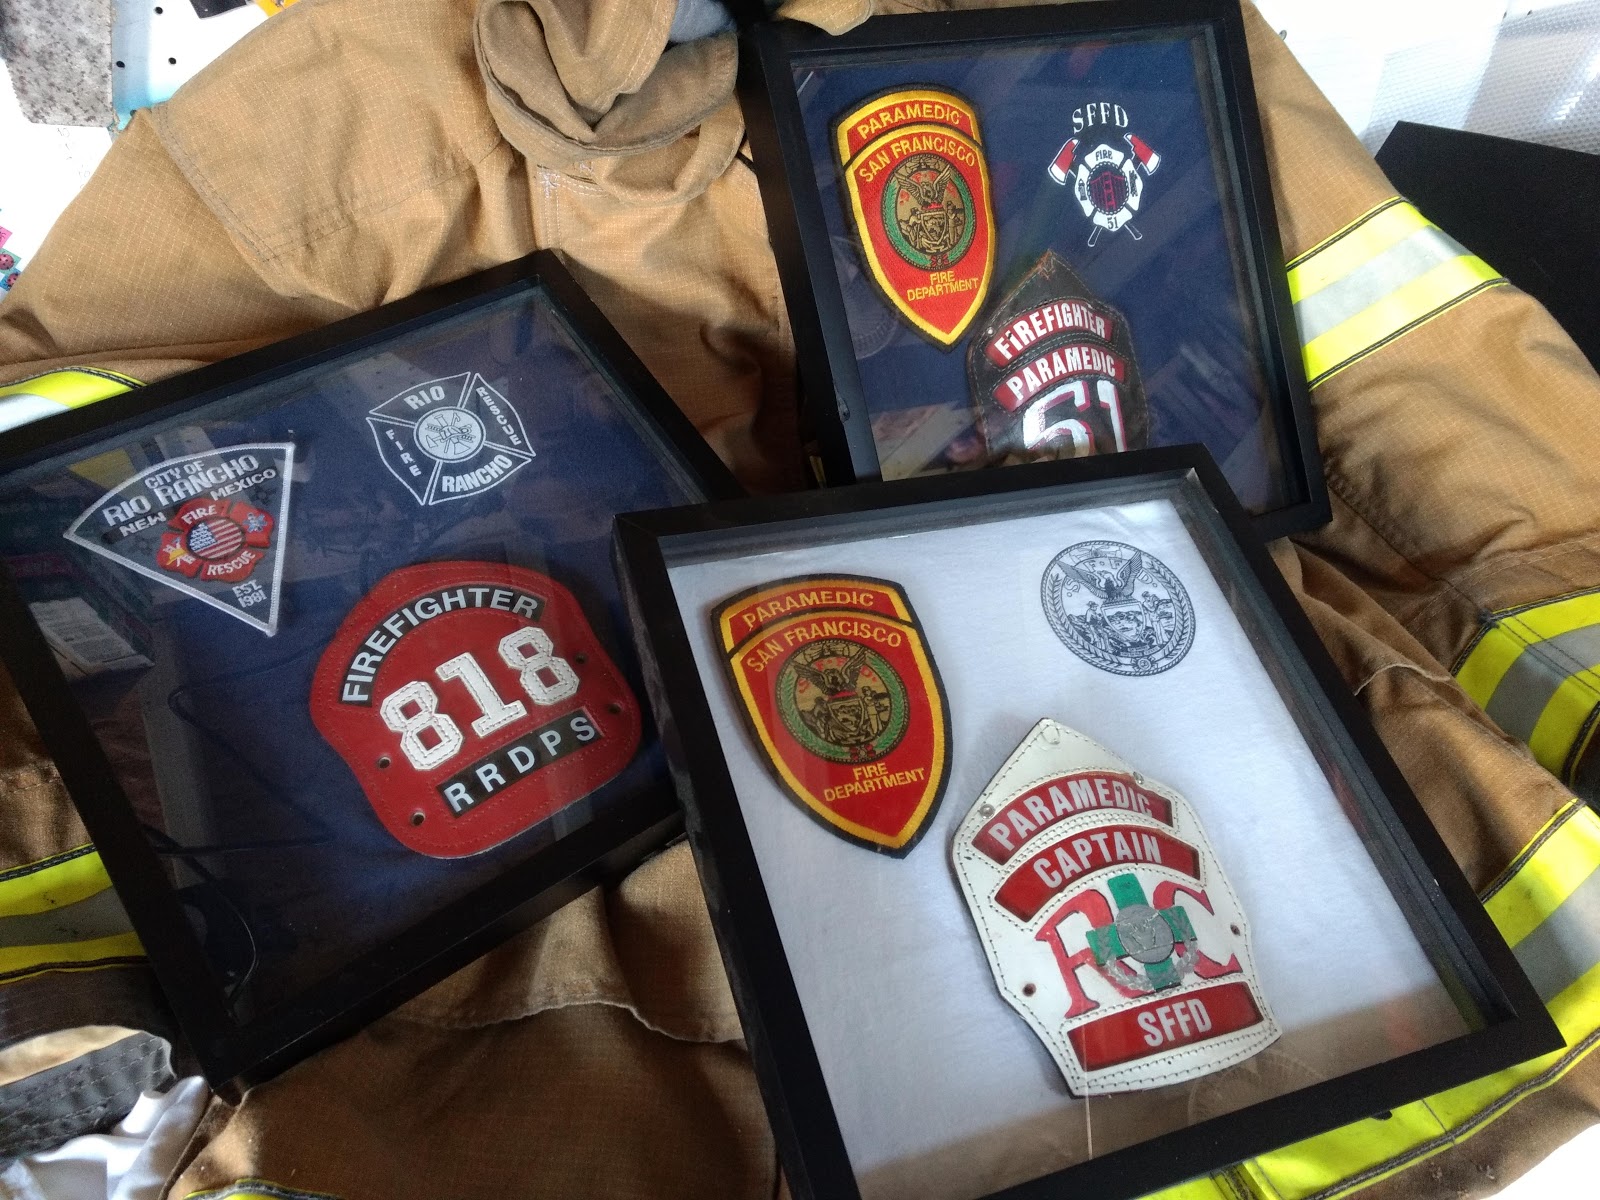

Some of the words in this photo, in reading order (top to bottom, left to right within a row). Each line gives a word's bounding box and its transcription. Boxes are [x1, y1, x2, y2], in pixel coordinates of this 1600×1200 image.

[857, 104, 961, 139] PARAMEDIC
[1072, 102, 1129, 134] SFFD
[859, 150, 891, 182] SAN
[890, 136, 975, 167] FRANCISCO
[1095, 149, 1113, 161] FIRE
[1107, 216, 1119, 230] 51
[907, 278, 979, 301] DEPARTMENT
[930, 271, 956, 285] FIRE
[1006, 346, 1117, 401] PARAMEDIC
[403, 385, 446, 410] RIO
[475, 386, 522, 446] RESCUE
[385, 429, 422, 477] FIRE
[102, 494, 152, 527] RIO
[153, 454, 260, 507] RANCHO
[144, 468, 182, 490] CITY
[183, 460, 205, 475] OF
[441, 454, 513, 493] RANCHO
[119, 511, 168, 538] NEW
[209, 468, 277, 502] MEXICO
[181, 504, 218, 526] FIRE
[206, 549, 257, 577] RESCUE
[238, 589, 268, 608] 1981
[742, 590, 875, 630] PARAMEDIC
[341, 587, 539, 703] FIREFIGHTER
[746, 639, 785, 674] SAN
[784, 620, 902, 649] FRANCISCO
[379, 625, 581, 772] 818
[823, 767, 926, 802] DEPARTMENT
[852, 762, 889, 781] FIRE
[988, 778, 1153, 851] PARAMEDIC
[1032, 831, 1163, 889] CAPTAIN
[1137, 998, 1212, 1048] SFFD
